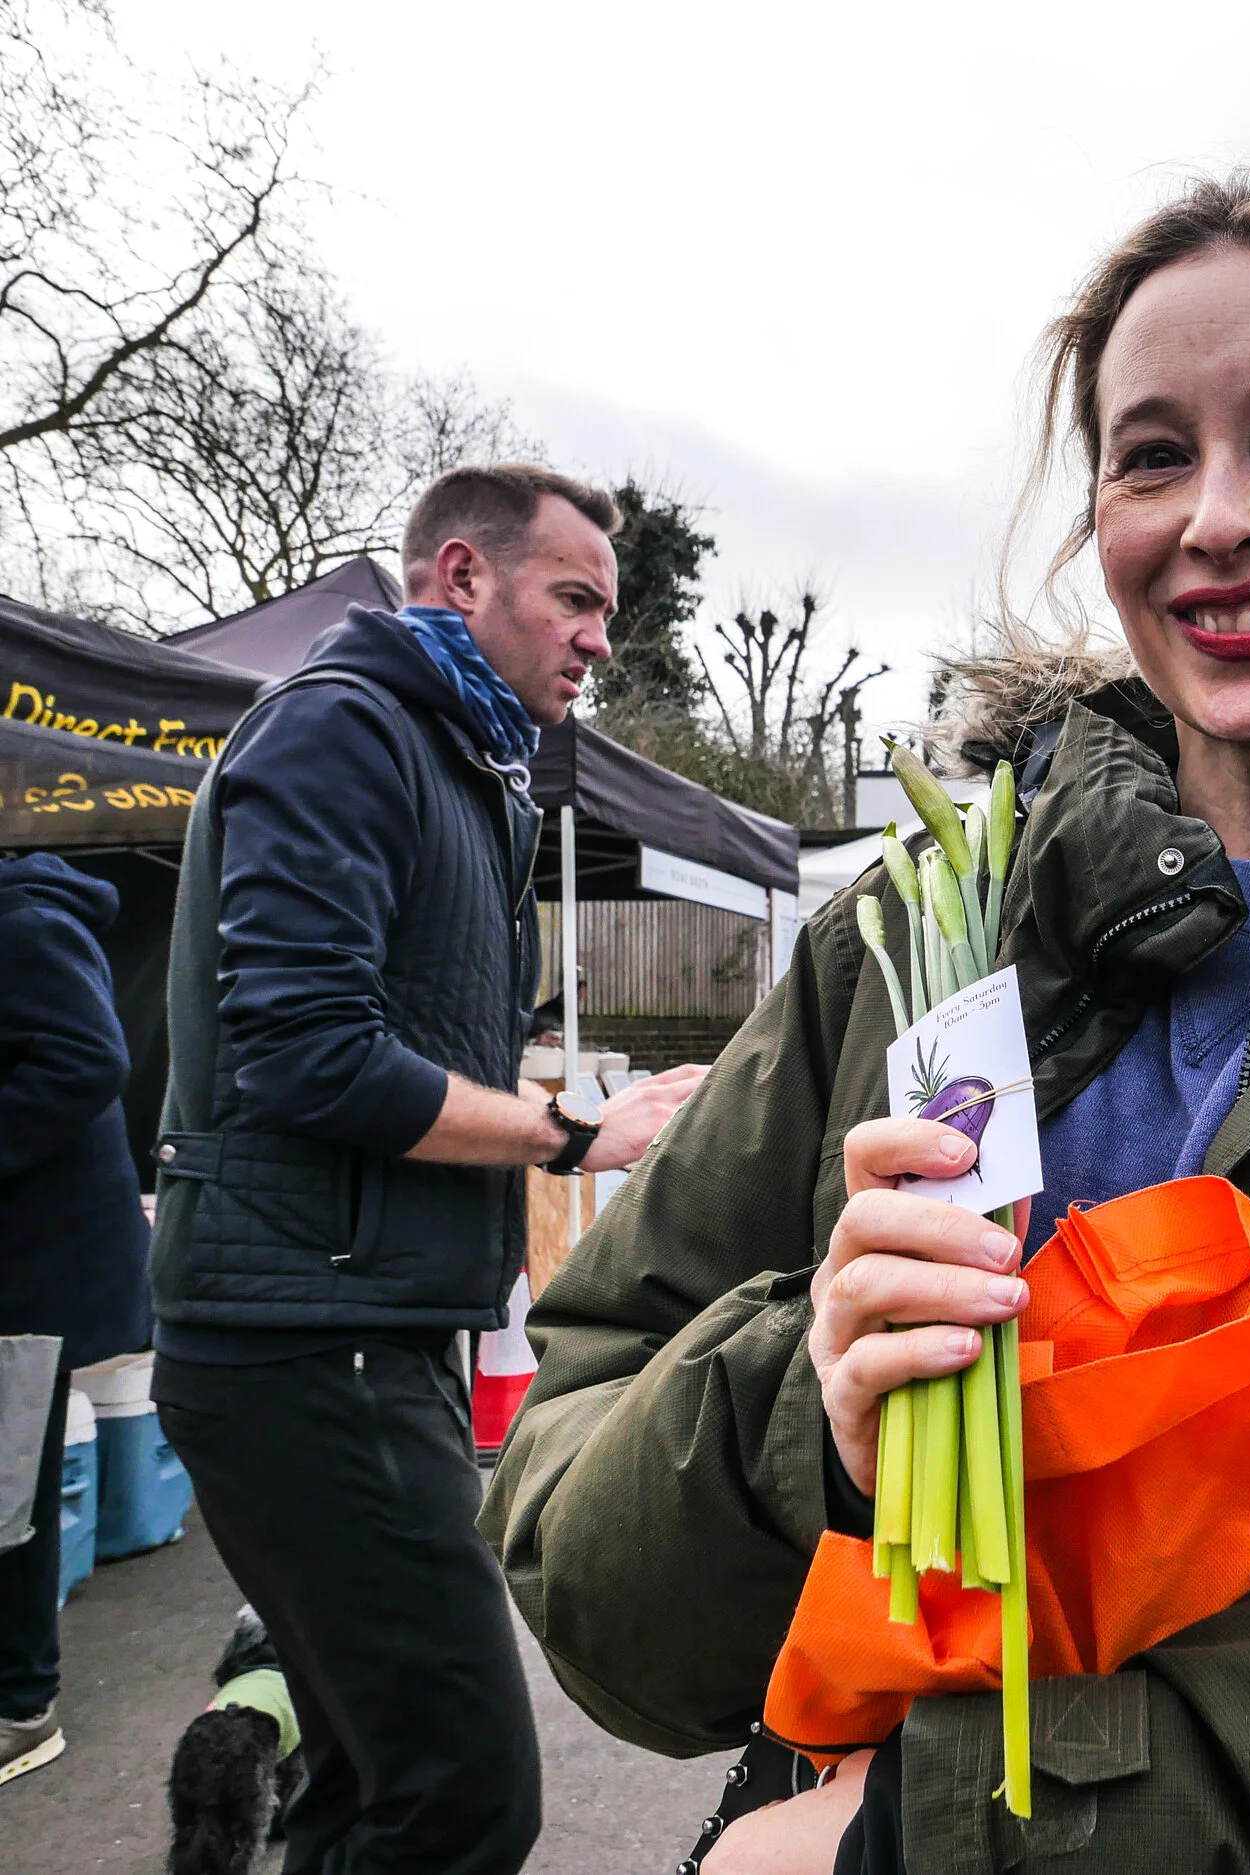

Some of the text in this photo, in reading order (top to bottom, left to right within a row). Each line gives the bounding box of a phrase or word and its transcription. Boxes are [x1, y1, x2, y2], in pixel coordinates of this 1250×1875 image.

[3, 681, 227, 761] Direct Fro
[936, 981, 1008, 1023] Every Saturday
[944, 1012, 968, 1030] 10am
